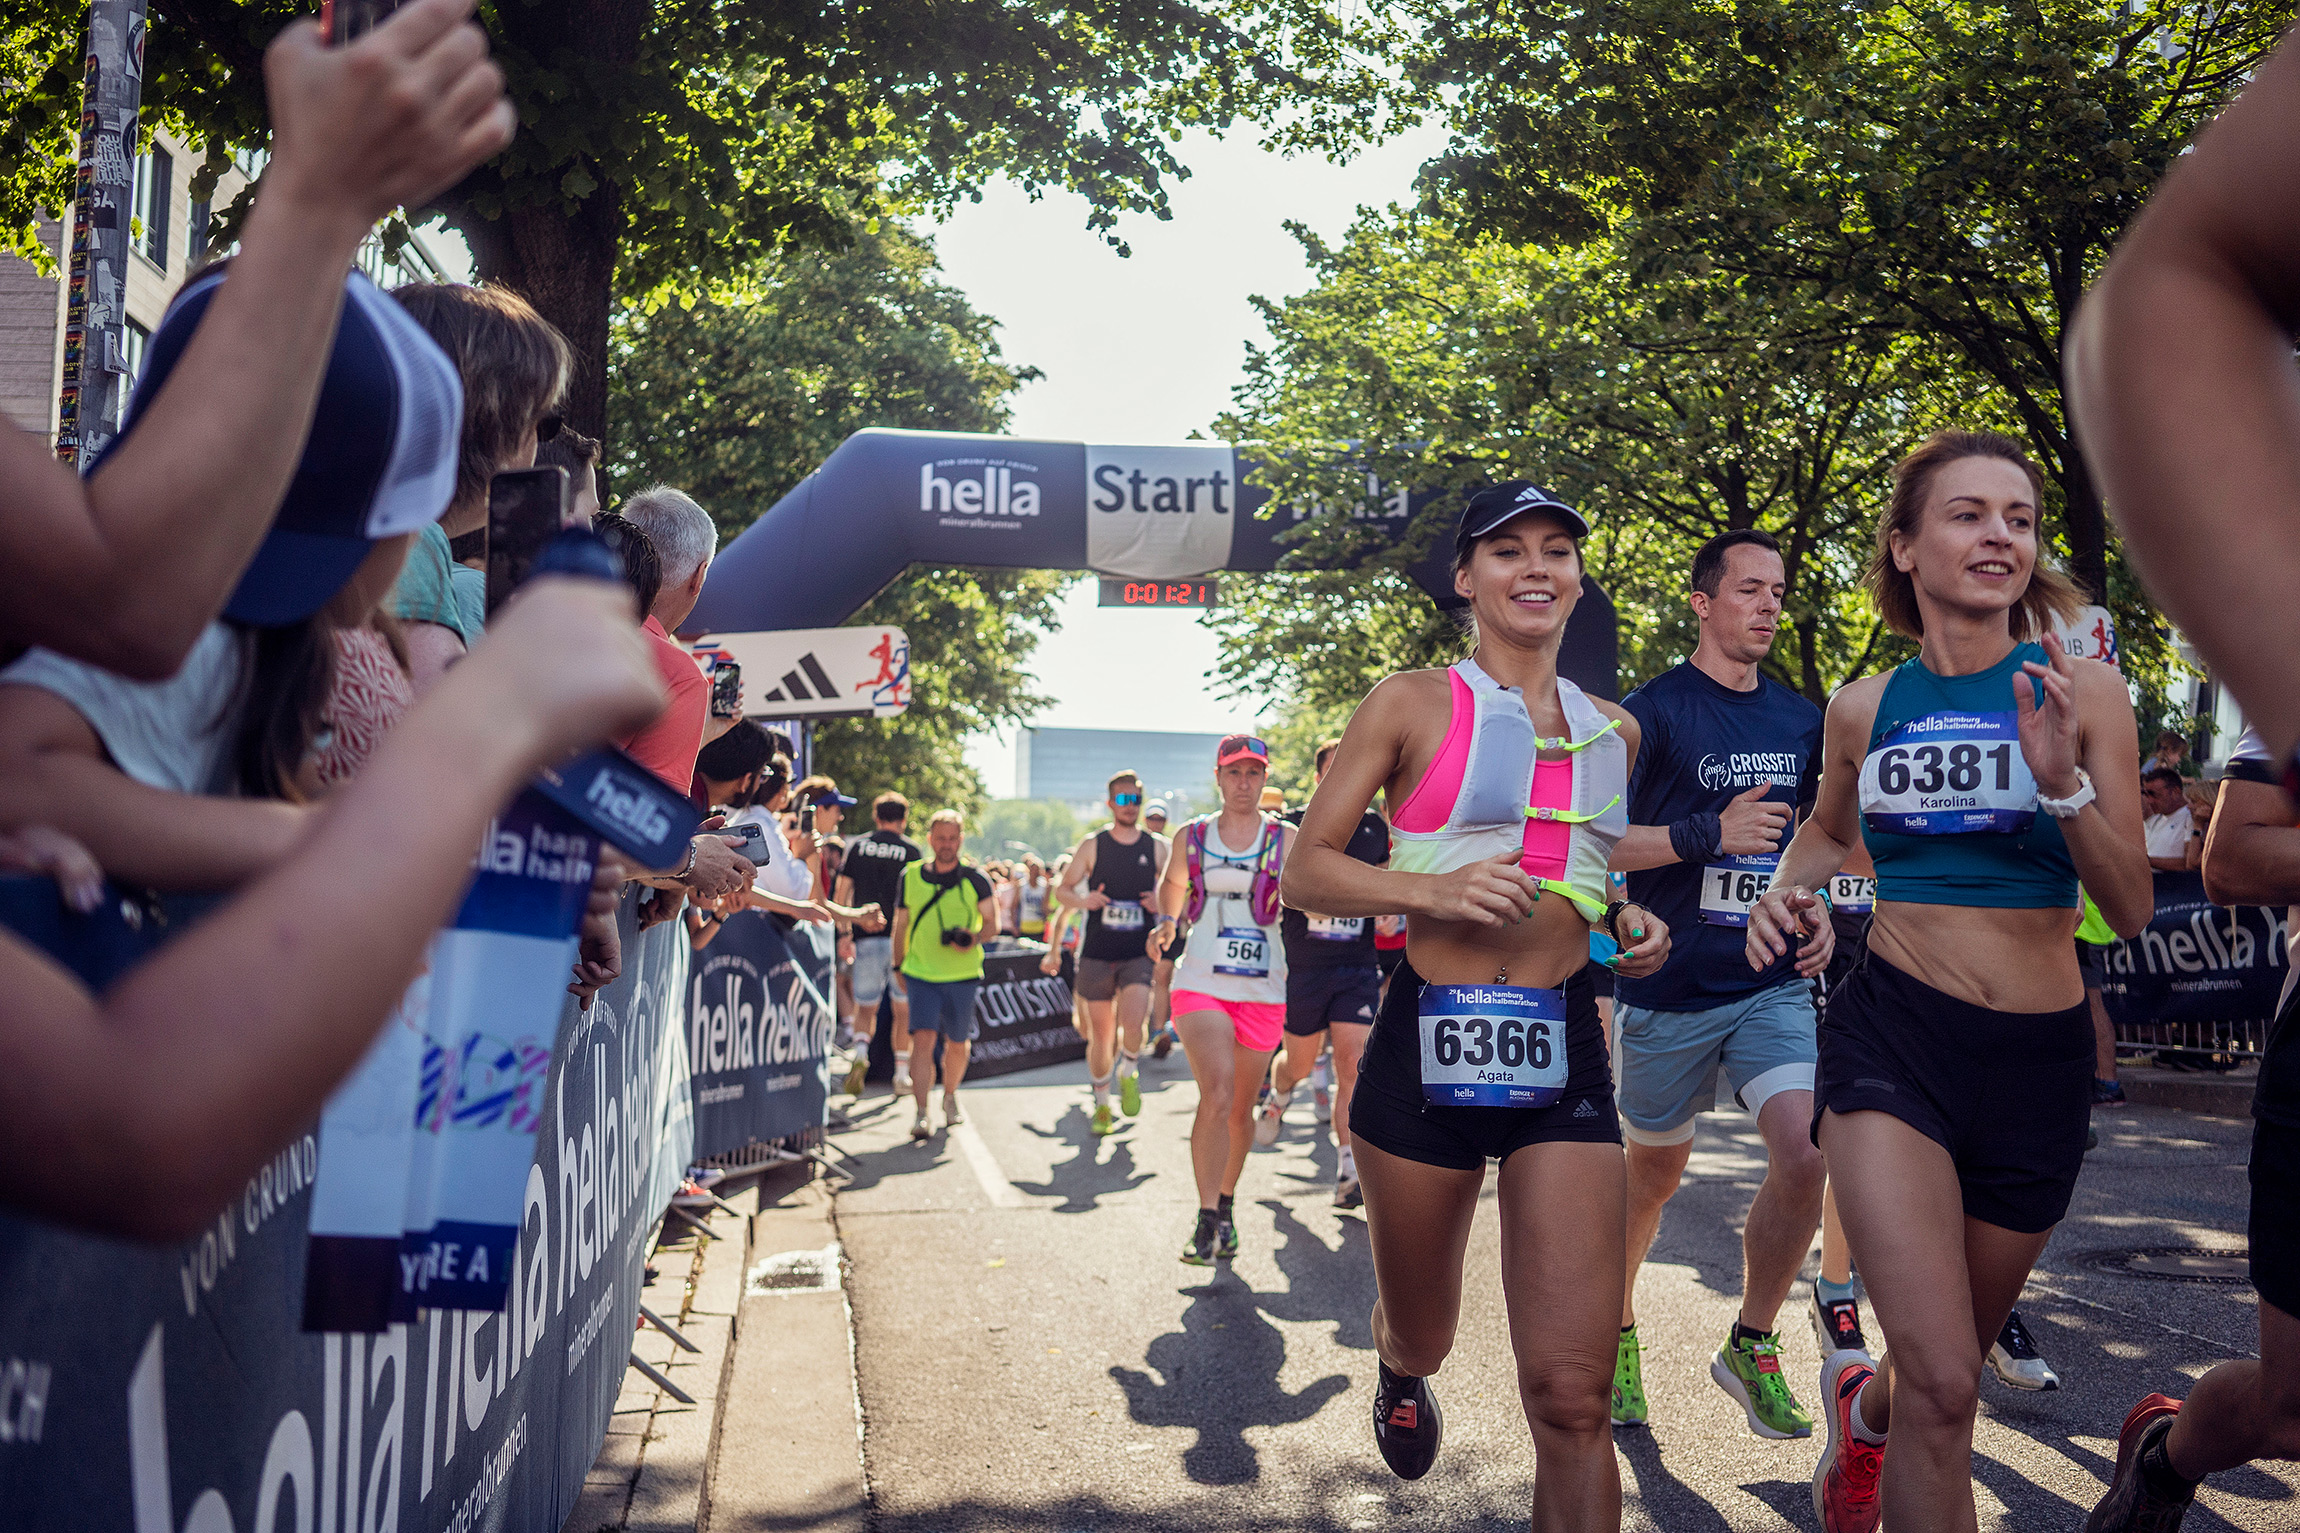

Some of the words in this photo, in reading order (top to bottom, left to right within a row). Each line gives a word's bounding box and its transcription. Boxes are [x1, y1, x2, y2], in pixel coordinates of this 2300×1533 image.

[920, 462, 1042, 517] hella
[1093, 463, 1229, 514] Start
[1124, 583, 1205, 604] 0:01:21
[1907, 716, 1944, 734] hella
[1943, 716, 1981, 724] hamburg
[1943, 722, 2001, 730] halbmarathon
[1729, 752, 1797, 774] CROSSFIT
[1878, 743, 2011, 796] 6381
[1733, 774, 1752, 787] MIT
[1754, 773, 1798, 788] SCHMACKES
[586, 767, 672, 846] hella
[1920, 795, 1977, 809] Karolina
[1905, 816, 1928, 827] hella
[1227, 941, 1262, 962] 564
[2140, 909, 2256, 975] hella
[2171, 977, 2244, 993] mineralbrunnen
[1456, 988, 1492, 1004] hella
[1492, 990, 1524, 1000] hamburg
[1492, 997, 1539, 1008] halbmarathon
[691, 972, 755, 1077] hella
[1434, 1018, 1552, 1070] 6366
[1476, 1069, 1514, 1083] Agata
[1454, 1088, 1475, 1098] hella
[1572, 1110, 1599, 1118] adidas
[556, 1042, 620, 1317] hella
[181, 1206, 236, 1318] VON
[243, 1133, 318, 1236] GRUND
[568, 1281, 614, 1376] mineralbrunnen
[441, 1411, 527, 1533] ineralbrunnen
